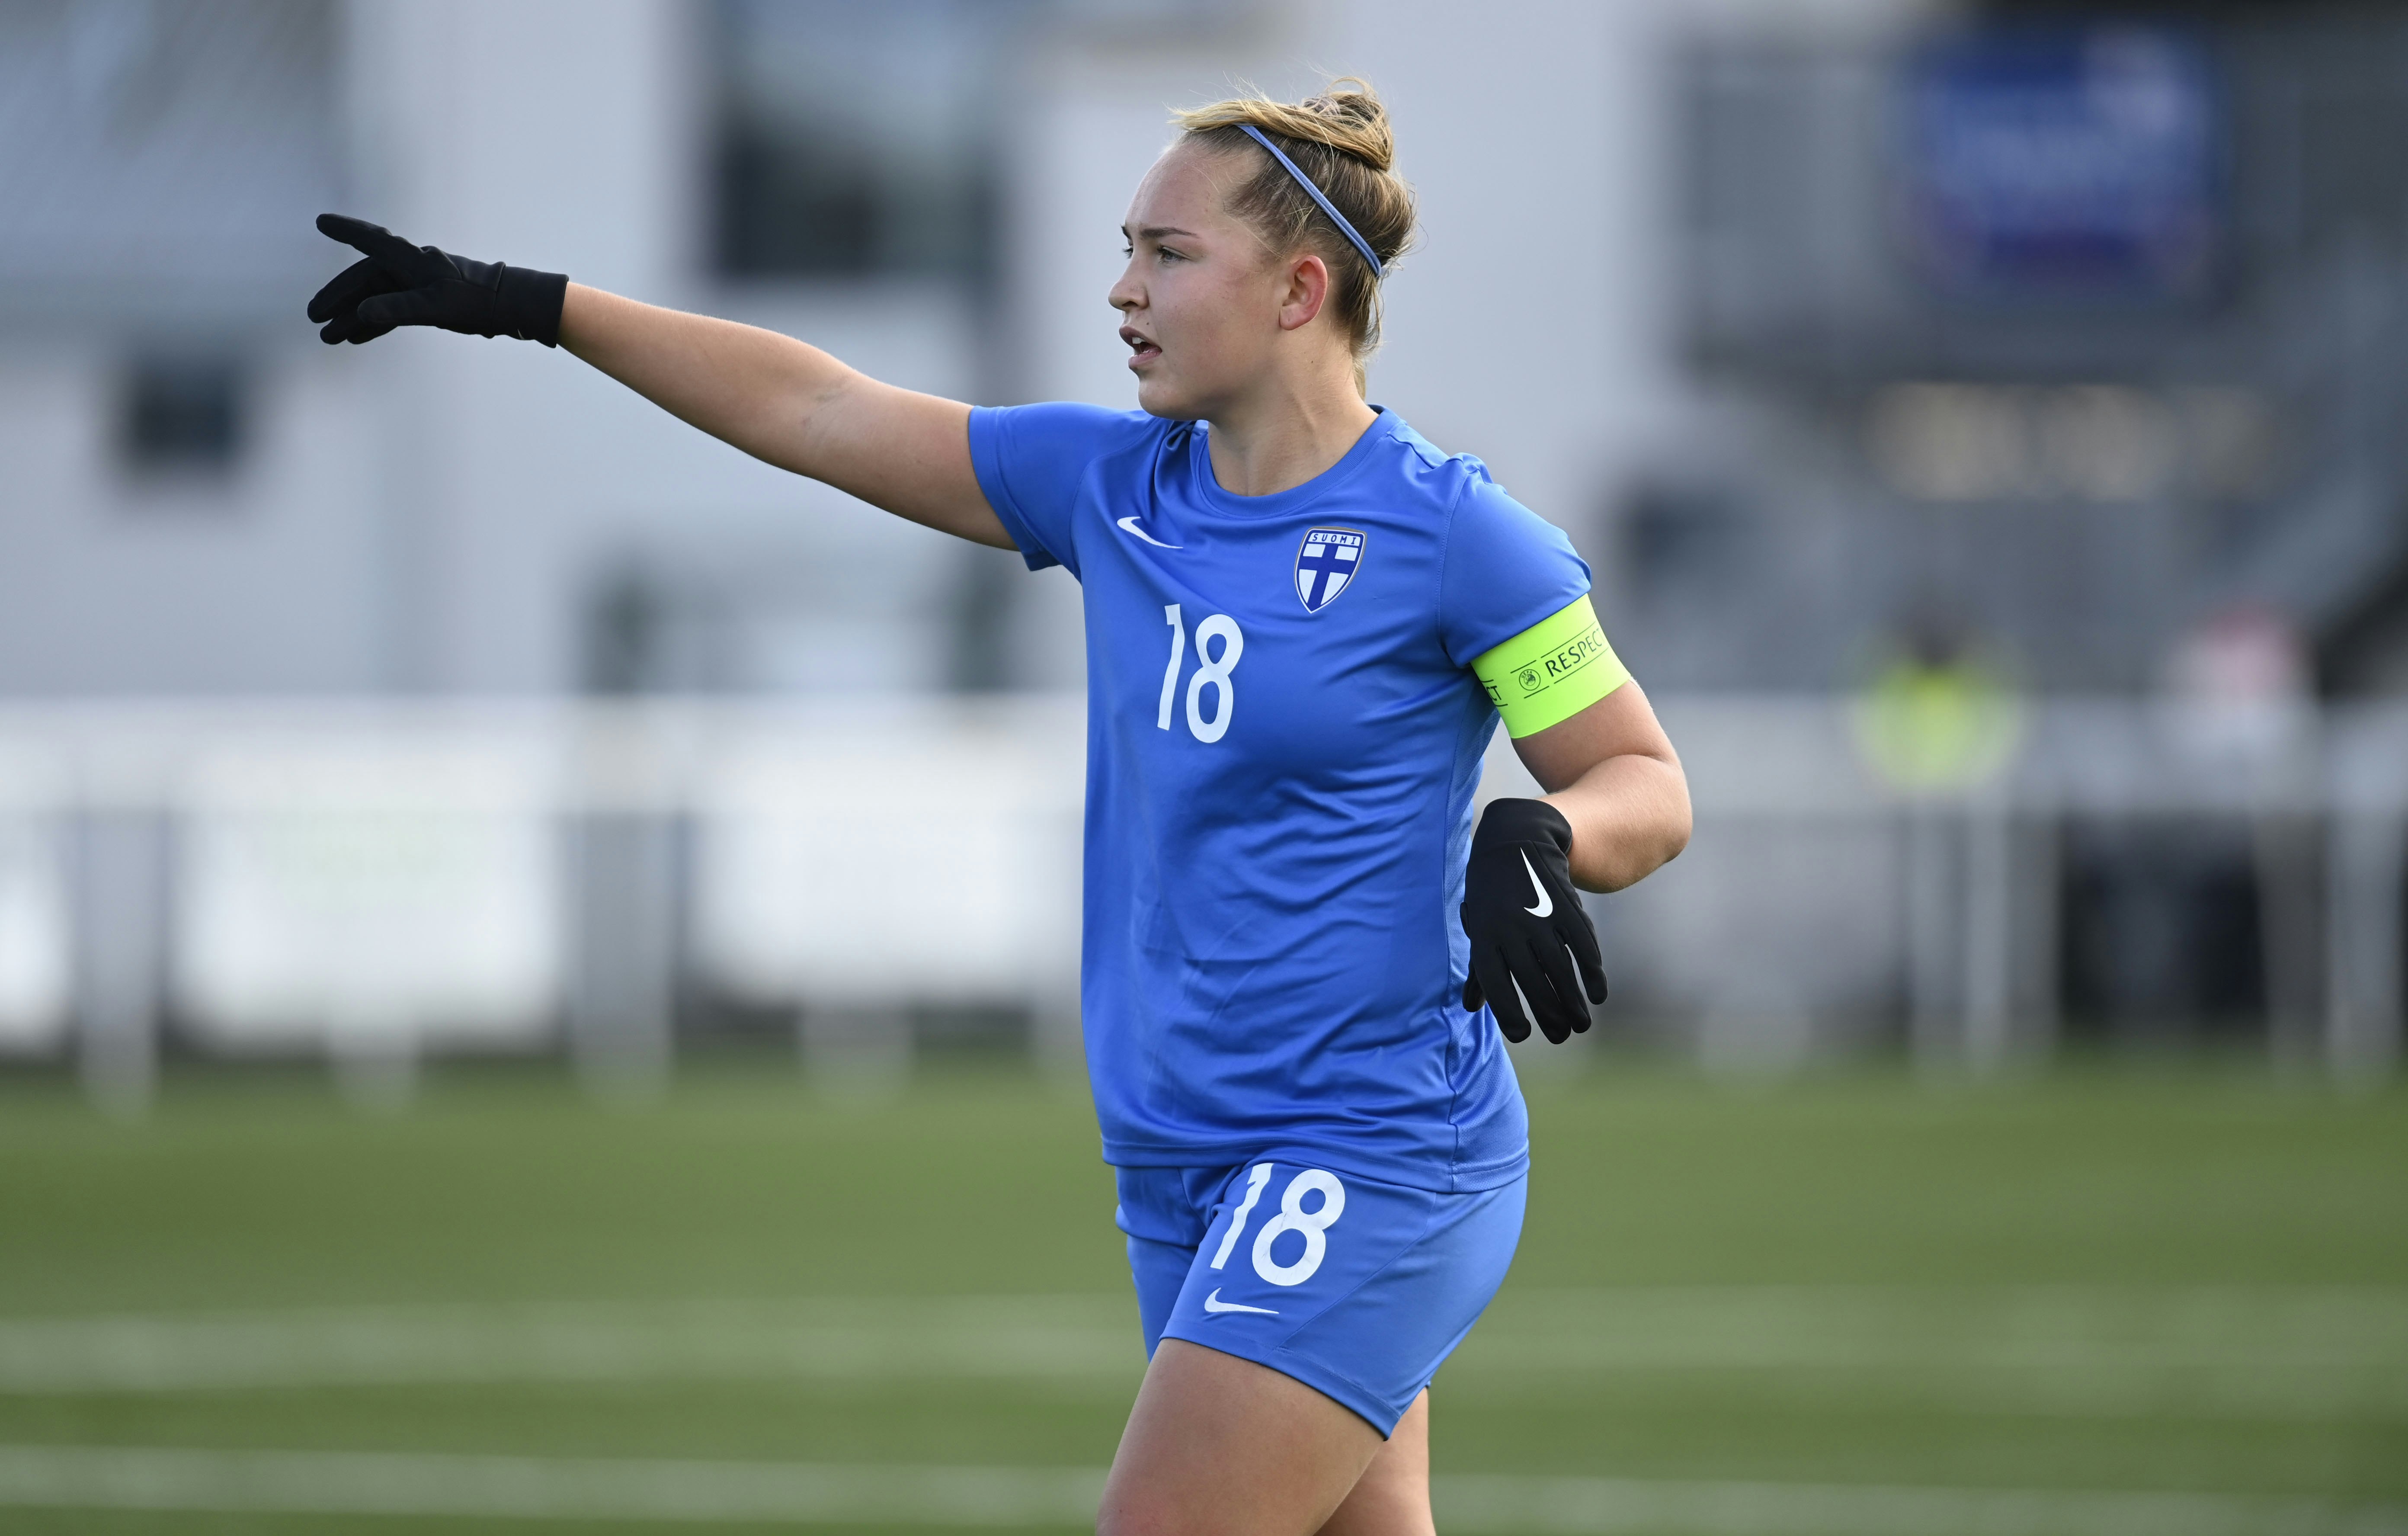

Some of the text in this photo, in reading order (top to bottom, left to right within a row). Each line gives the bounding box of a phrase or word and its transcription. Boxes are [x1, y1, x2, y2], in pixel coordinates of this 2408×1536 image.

[1312, 533, 1357, 545] SUOMI
[1157, 603, 1244, 743] 18
[1210, 1162, 1345, 1286] 18
